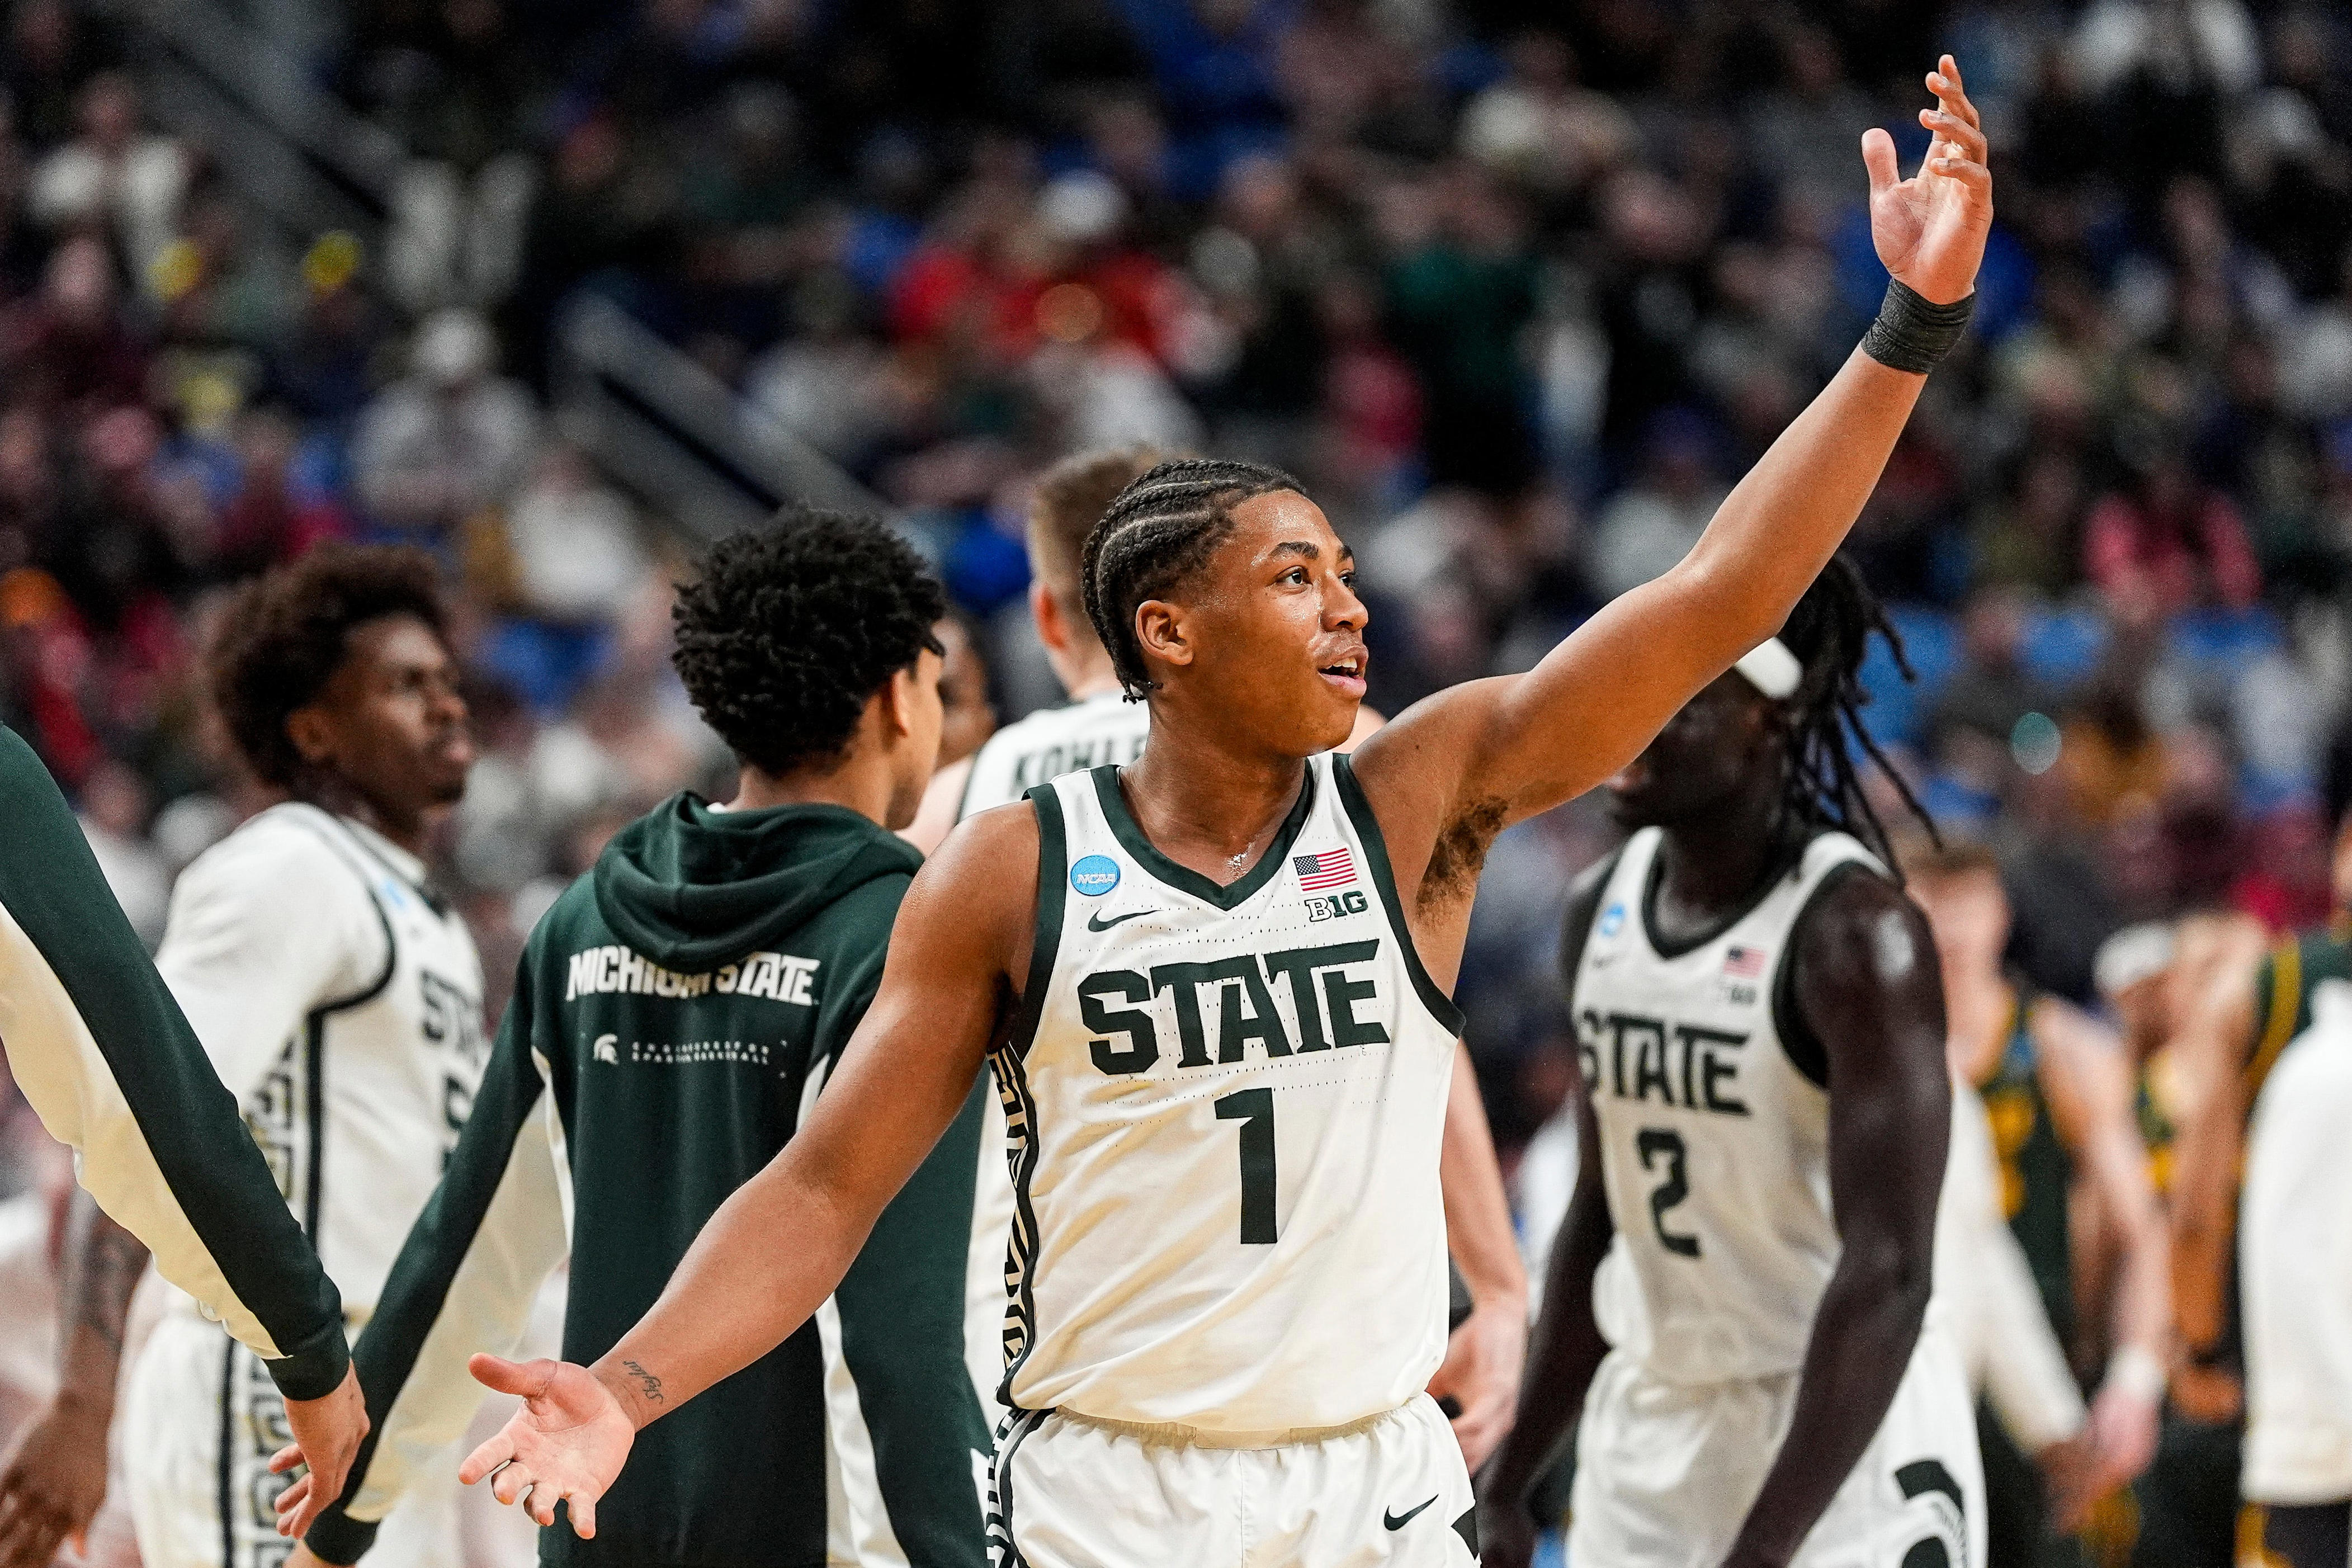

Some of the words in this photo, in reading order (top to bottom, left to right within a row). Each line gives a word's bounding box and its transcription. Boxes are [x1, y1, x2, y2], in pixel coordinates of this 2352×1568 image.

[1076, 873, 1116, 884] NCAA
[1078, 939, 1390, 1075] STATE
[1578, 1009, 1751, 1117] STATE
[1216, 1088, 1277, 1245] 1
[1635, 1127, 1702, 1258] 2
